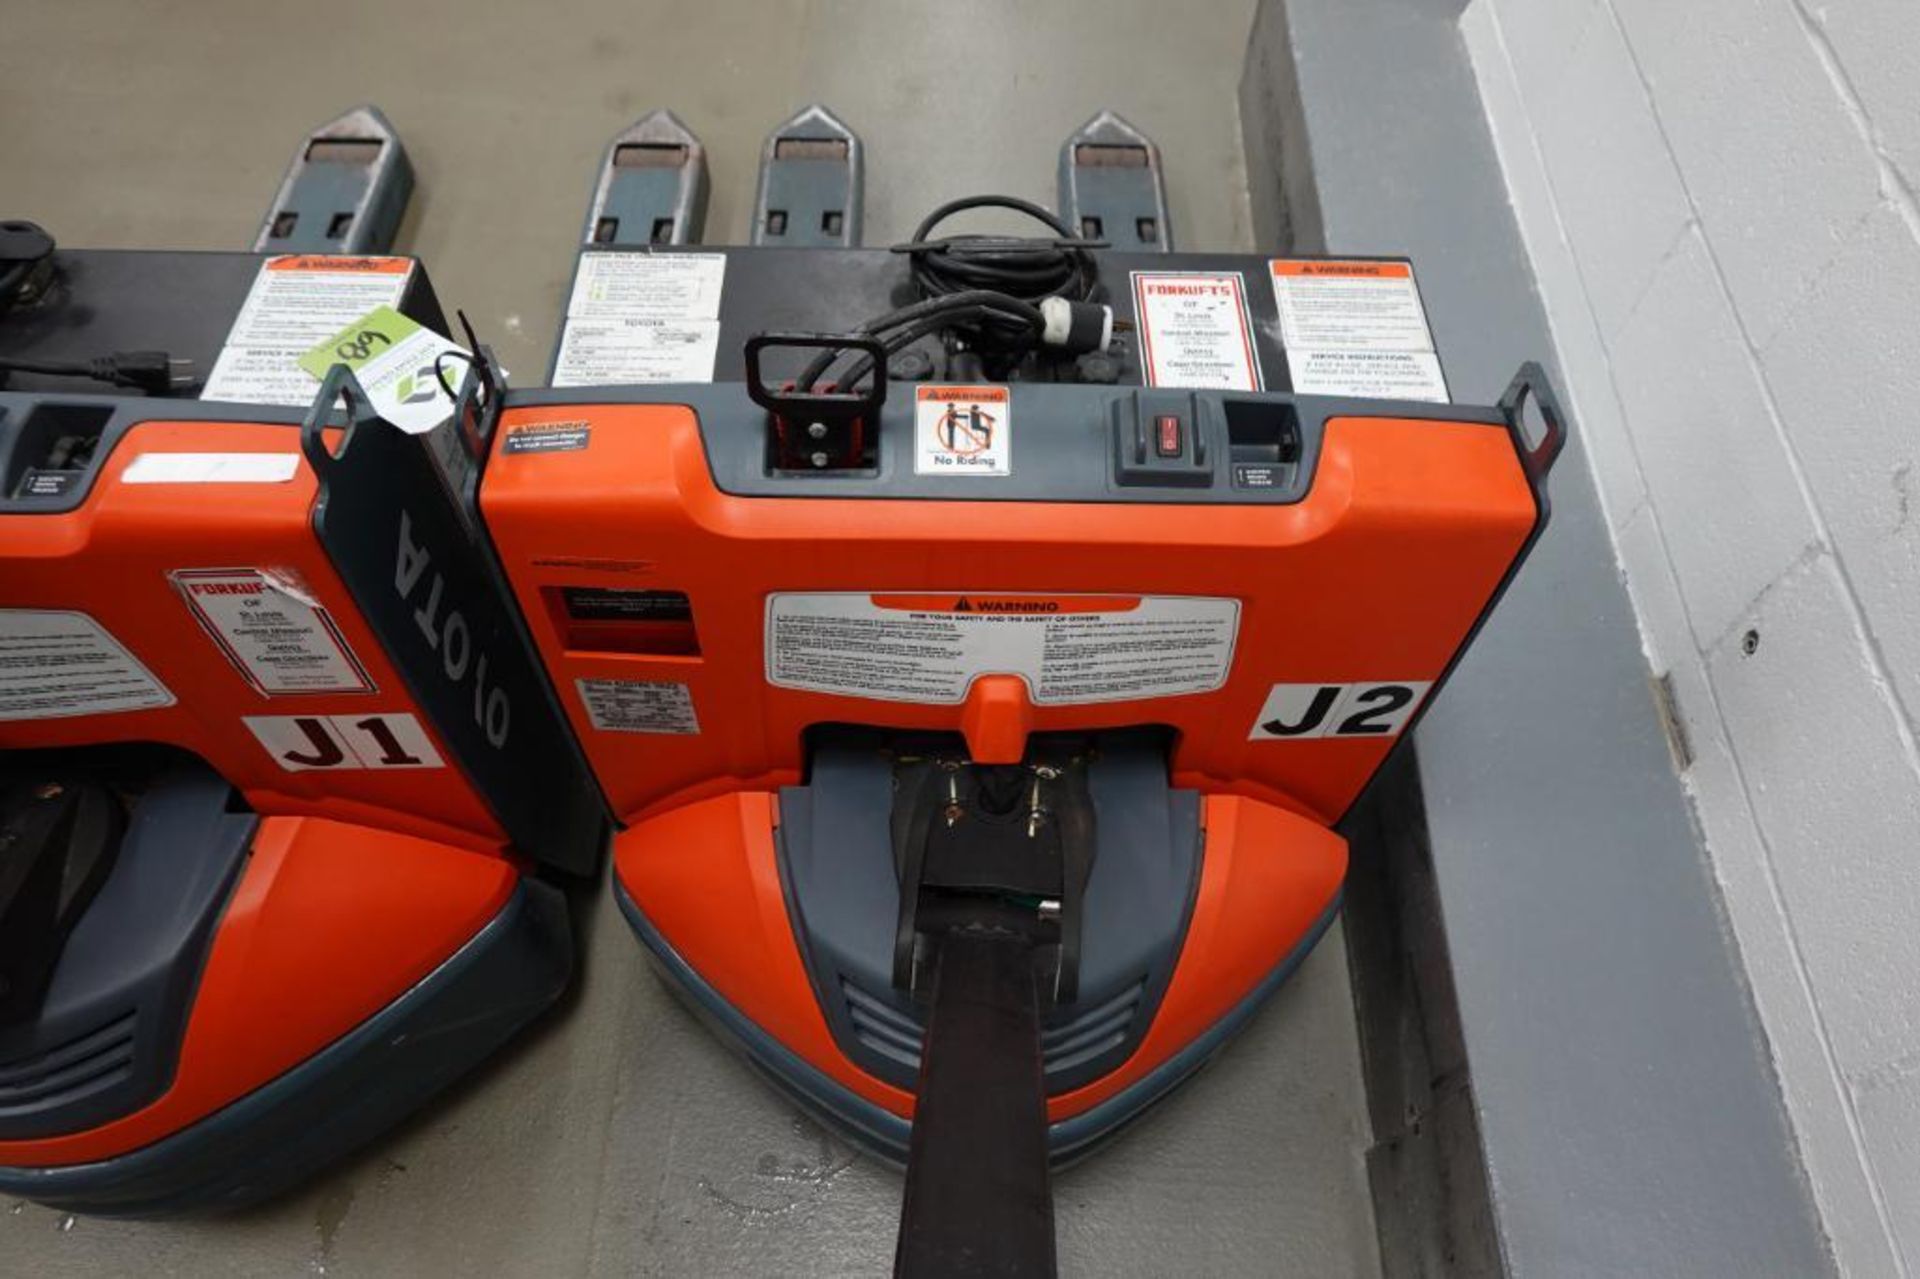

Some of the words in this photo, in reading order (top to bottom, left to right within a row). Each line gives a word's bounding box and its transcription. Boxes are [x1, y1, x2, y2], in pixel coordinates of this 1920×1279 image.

[942, 390, 1003, 402] WARNING
[934, 455, 953, 466] No
[956, 455, 996, 469] Riding
[977, 601, 1059, 612] WARNING
[955, 614, 983, 622] SAFETY
[986, 615, 1005, 623] AND
[1007, 615, 1023, 623] THE
[1025, 615, 1052, 623] SAFETY
[1054, 615, 1066, 623] OF
